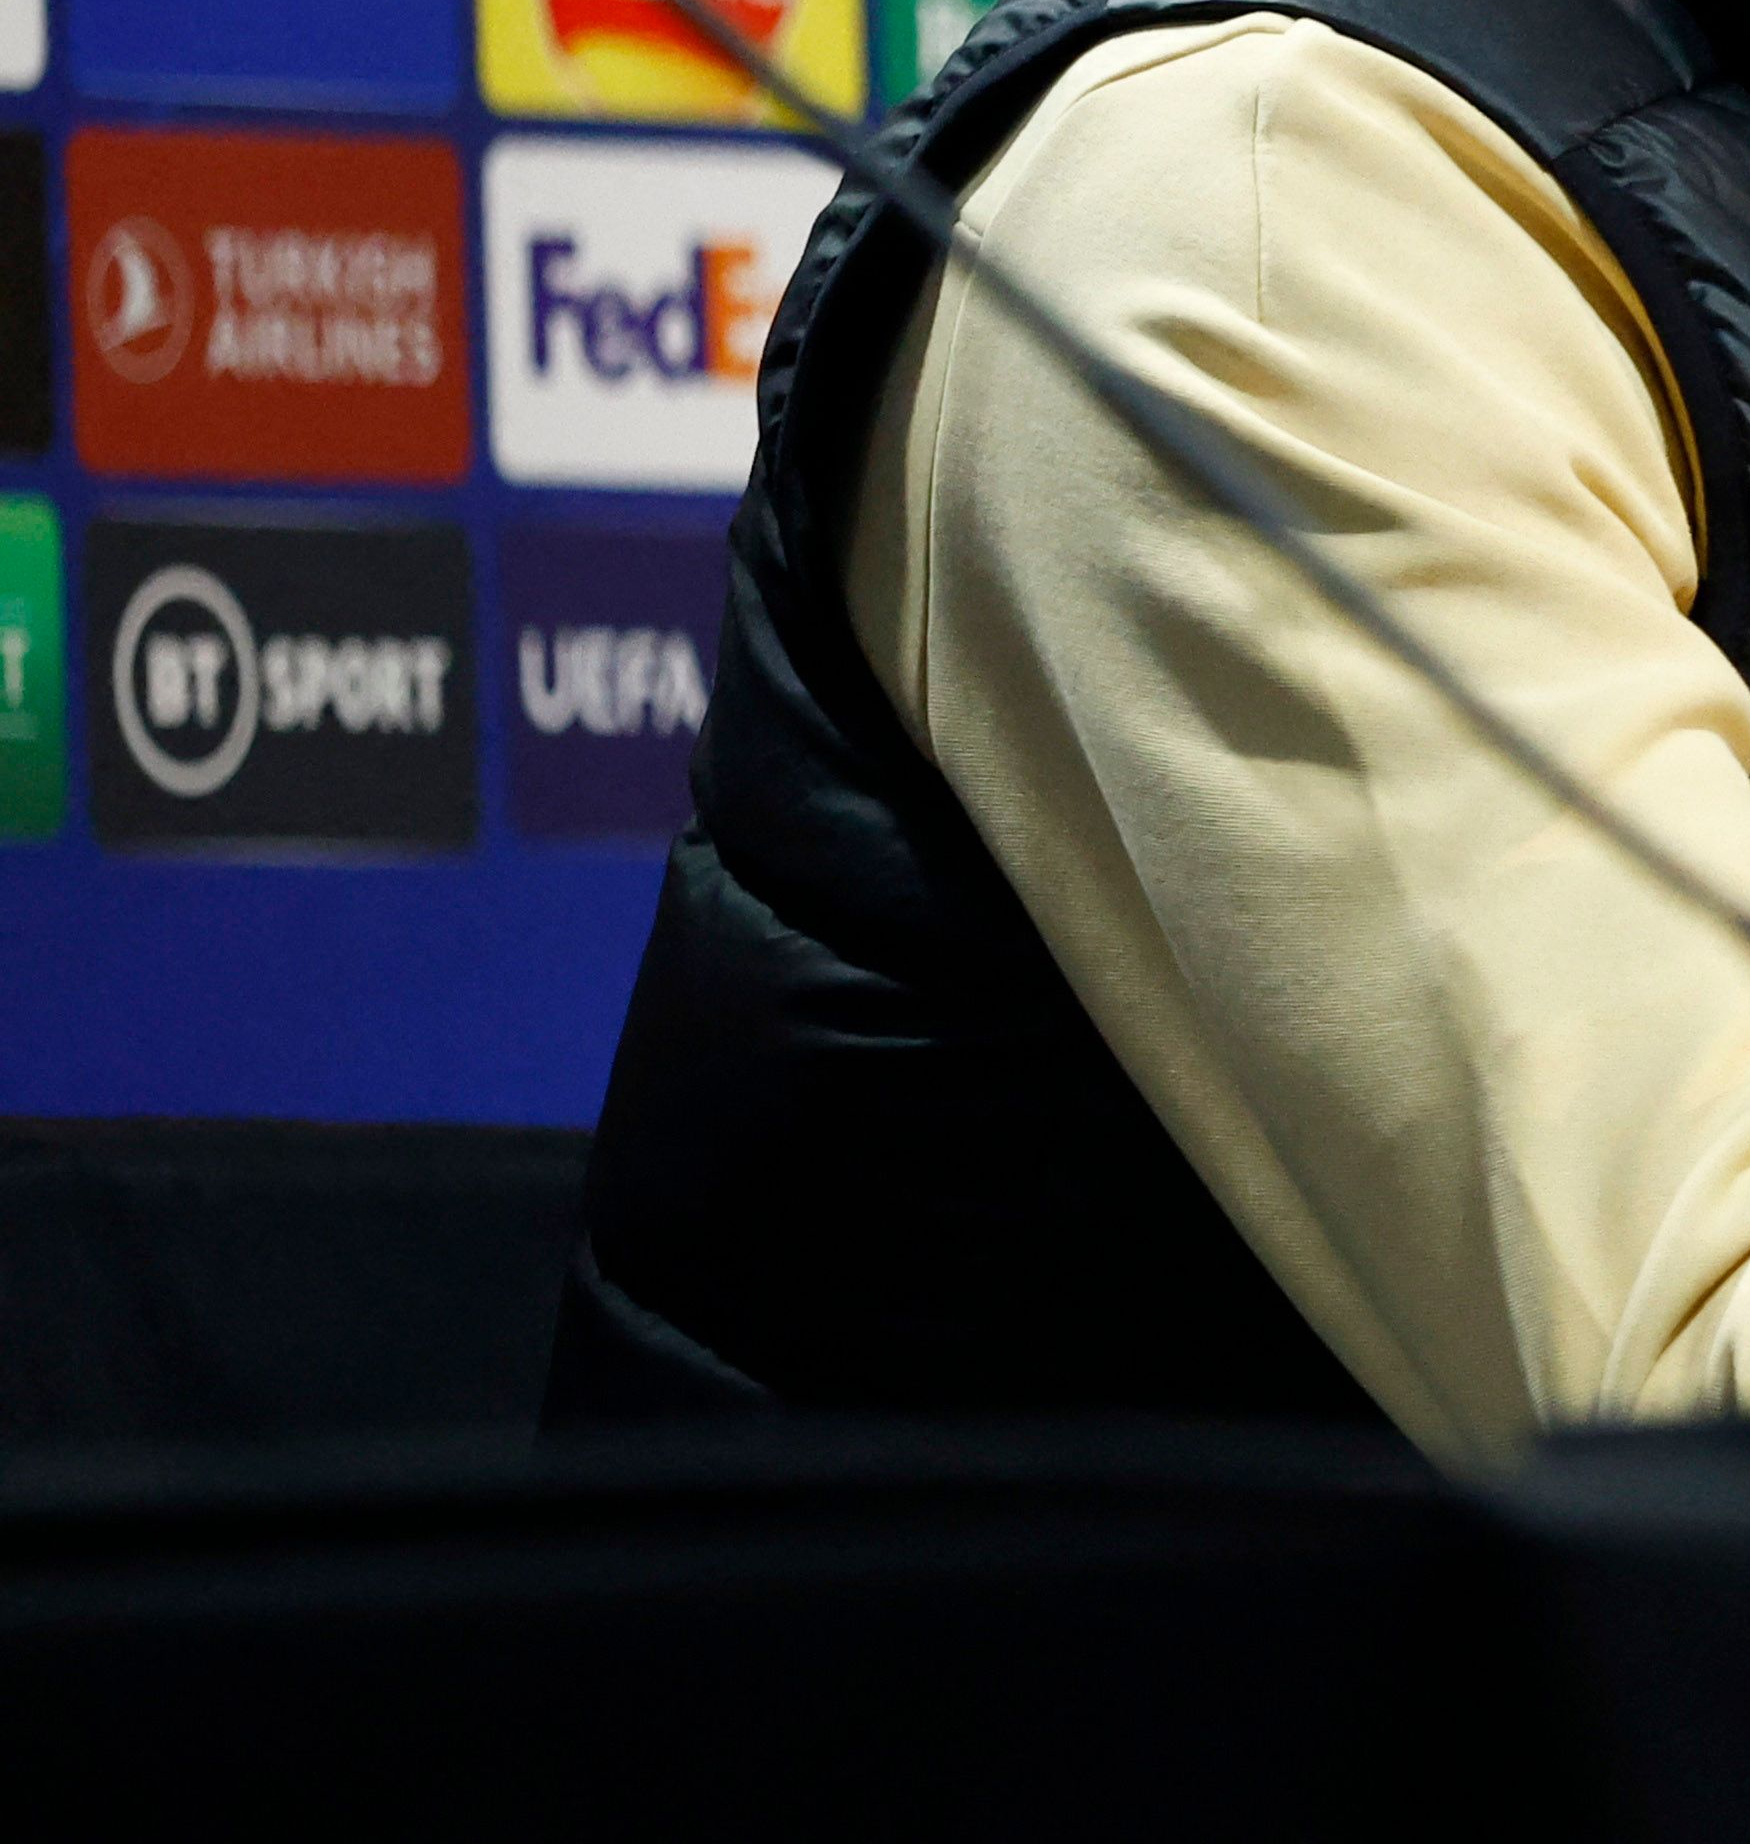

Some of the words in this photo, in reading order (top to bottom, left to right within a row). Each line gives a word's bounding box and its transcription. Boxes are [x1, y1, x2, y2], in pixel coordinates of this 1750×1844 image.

[207, 226, 438, 301] TURKISH
[207, 312, 441, 388] AIRLINES
[527, 232, 774, 392] FedE
[144, 631, 232, 731] BT
[260, 634, 450, 734] SPORT
